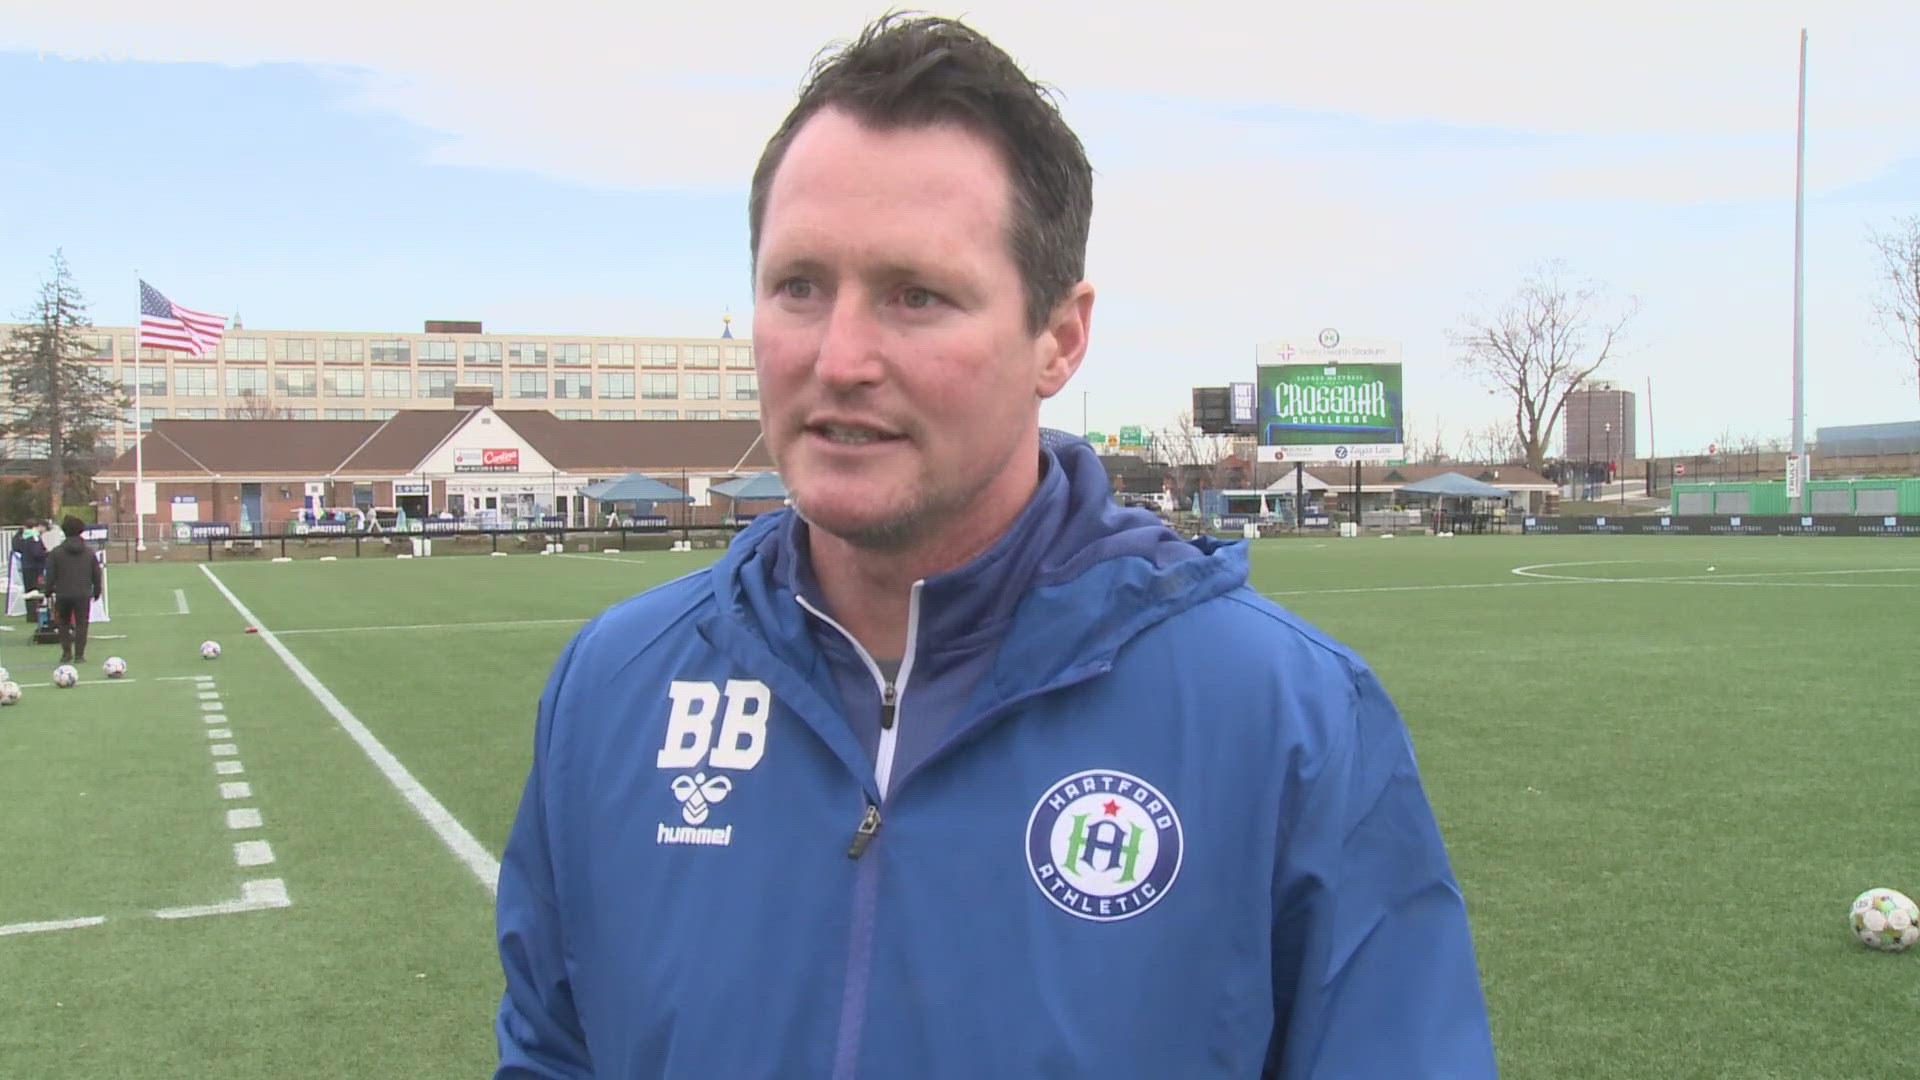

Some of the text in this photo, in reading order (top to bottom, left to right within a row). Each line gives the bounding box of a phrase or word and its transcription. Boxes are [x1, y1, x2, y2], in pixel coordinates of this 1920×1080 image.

[1275, 380, 1386, 418] CROSSBAR
[1292, 414, 1368, 424] CHALLENGE
[193, 526, 230, 537] HARTFORD
[656, 679, 771, 771] BB
[1048, 776, 1172, 830] HARTFORD
[656, 822, 733, 846] hummel
[1038, 862, 1157, 914] ATHLETIC
